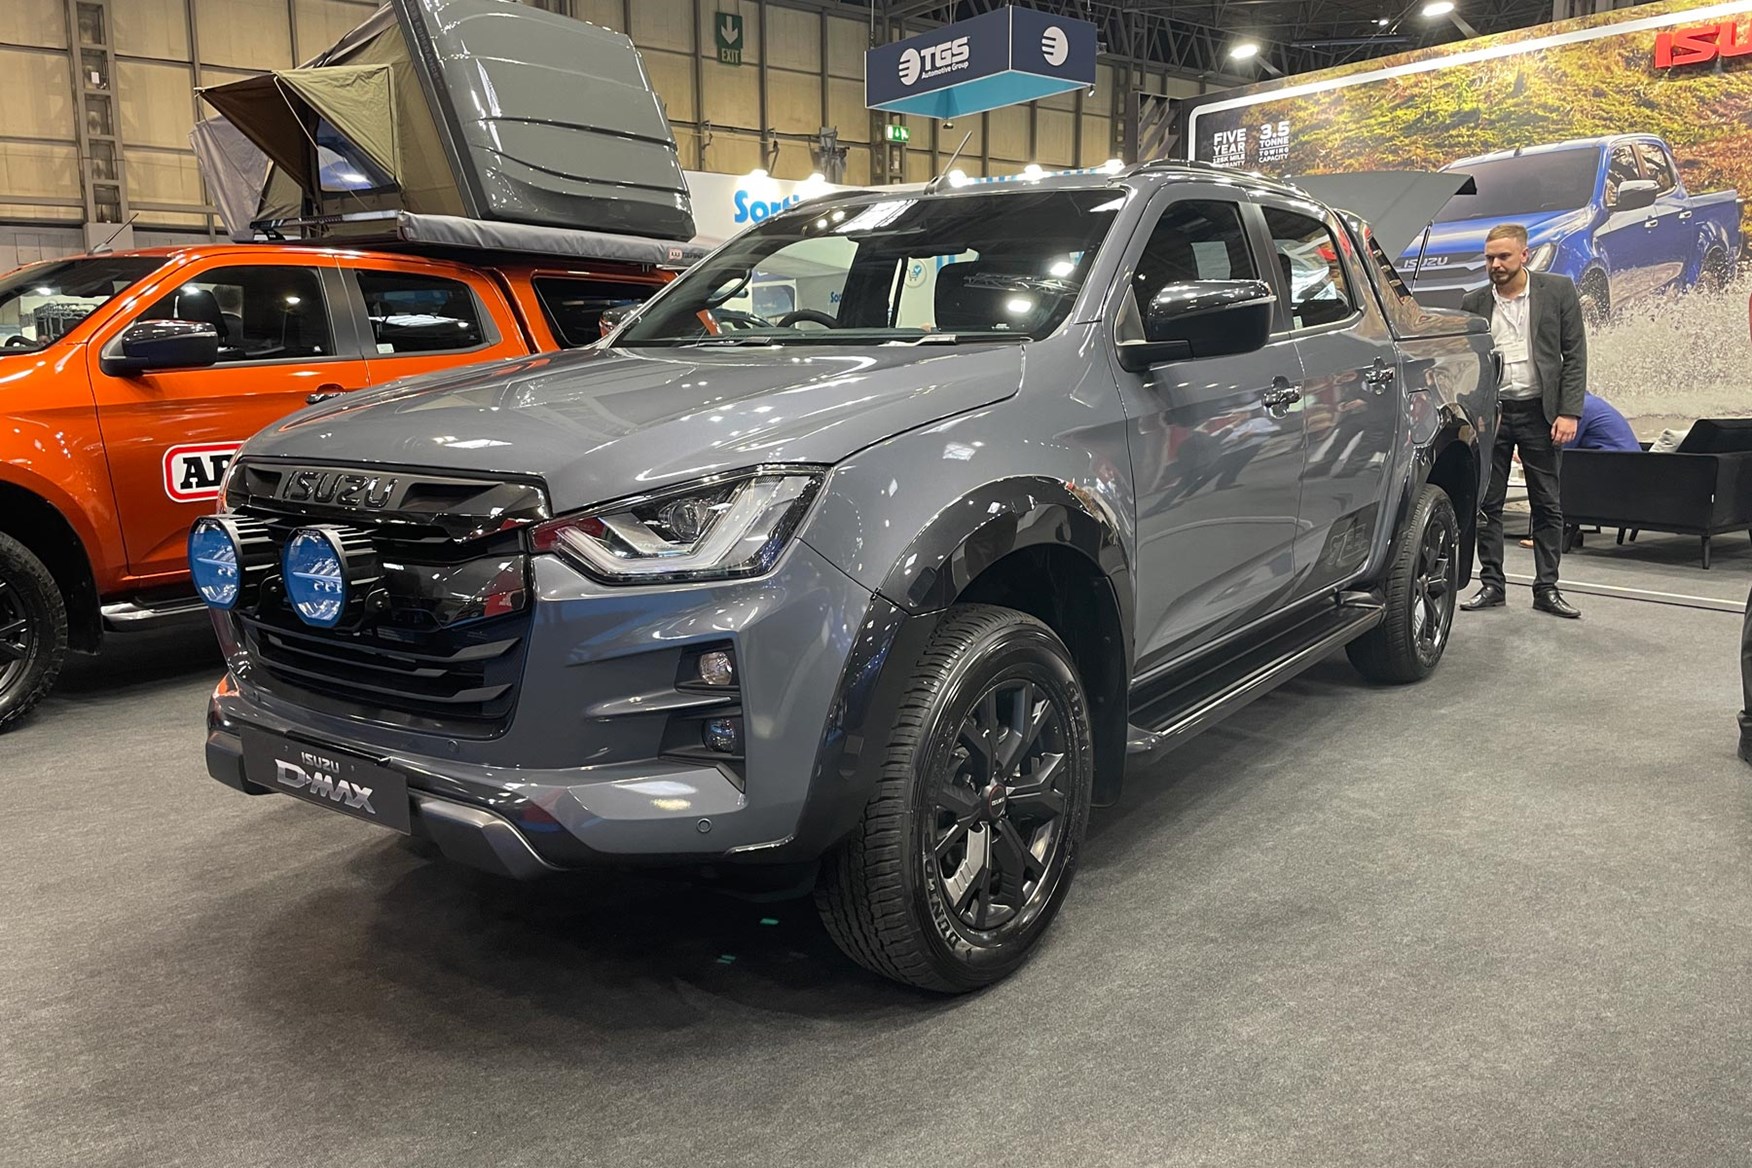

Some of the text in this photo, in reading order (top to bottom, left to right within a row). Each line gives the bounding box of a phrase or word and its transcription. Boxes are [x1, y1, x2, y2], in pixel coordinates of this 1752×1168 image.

[721, 48, 740, 63] EXIT
[921, 36, 969, 71] TGS
[922, 61, 969, 79] Automotive Group
[1213, 128, 1246, 146] FIVE
[1260, 121, 1290, 140] 3.5
[1213, 142, 1245, 156] YEAR
[1259, 136, 1289, 148] TONNE
[1258, 154, 1288, 163] CAPACITY
[1259, 147, 1289, 156] TOWING
[1404, 256, 1448, 268] ISUZU
[283, 470, 398, 507] ISUZU
[301, 751, 340, 774] ISUZU
